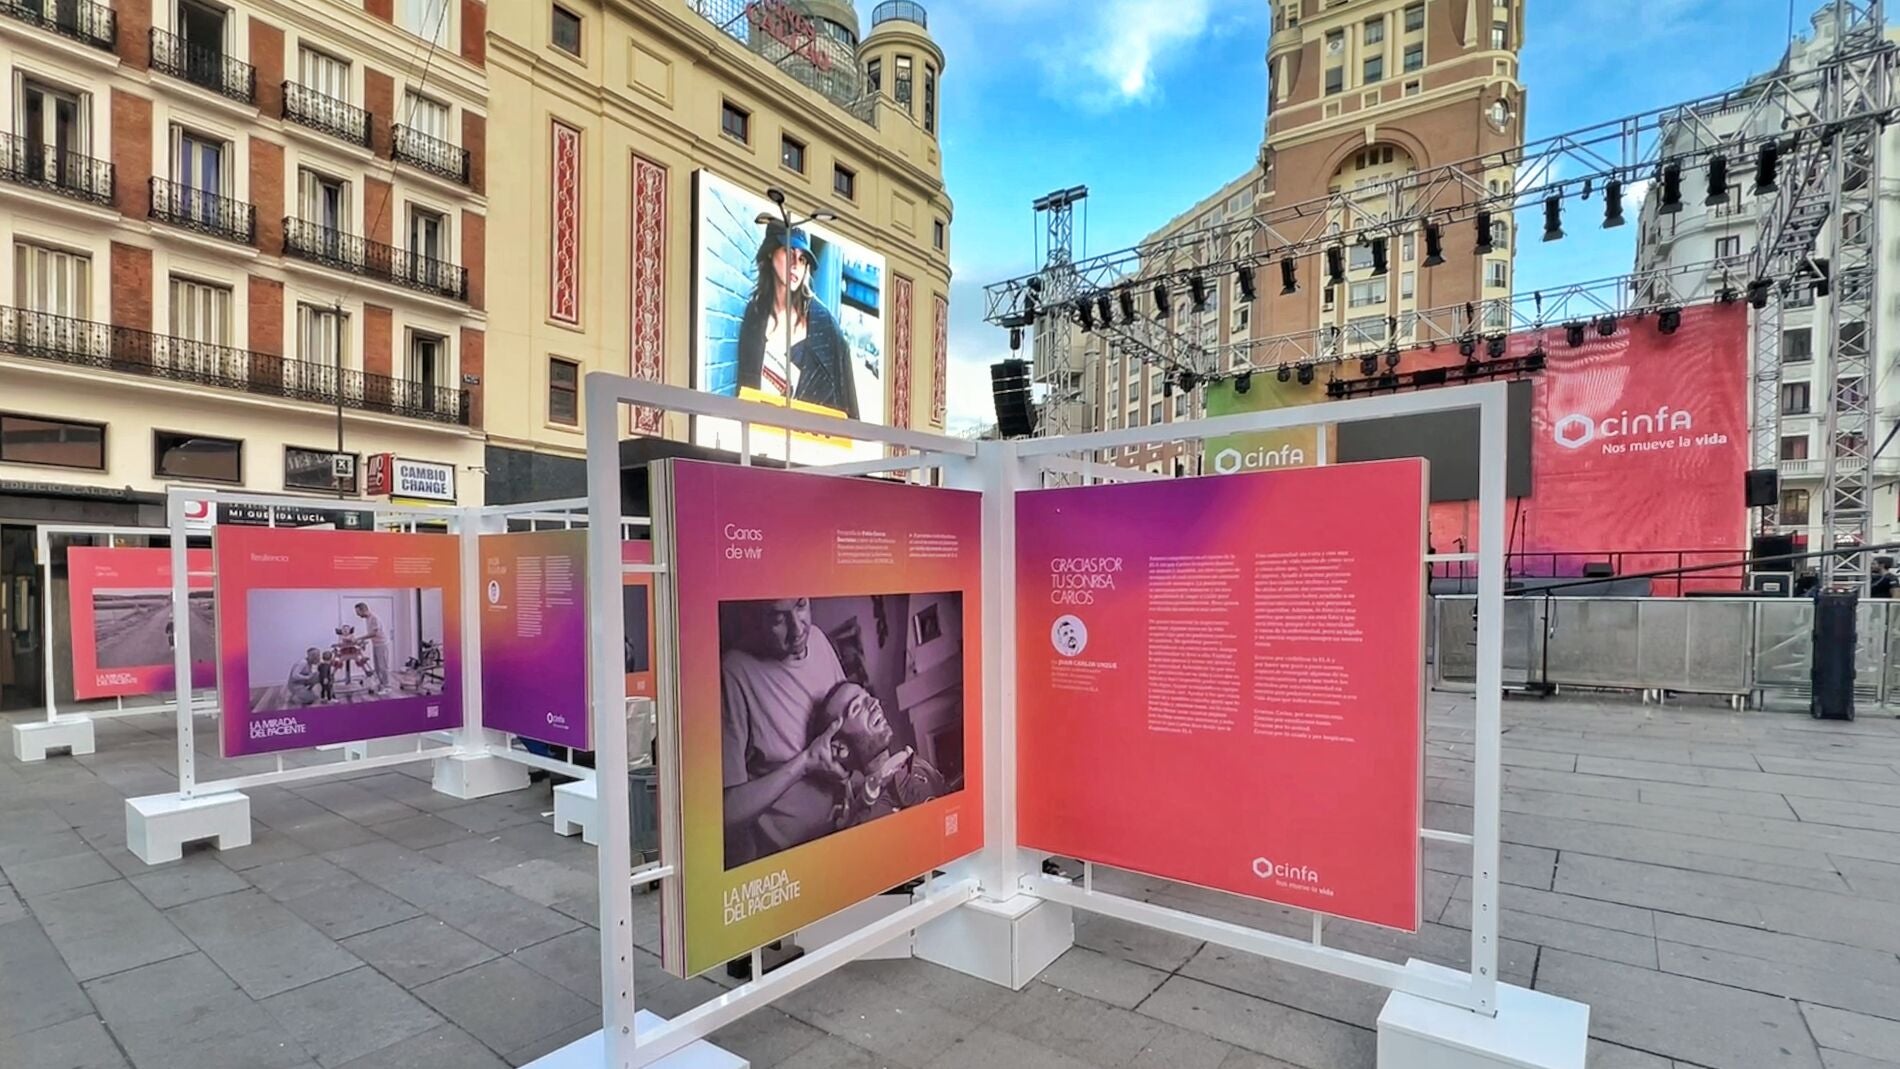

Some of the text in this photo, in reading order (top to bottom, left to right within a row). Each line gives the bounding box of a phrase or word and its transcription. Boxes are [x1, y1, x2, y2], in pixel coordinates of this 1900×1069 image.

[1602, 433, 1728, 455] Nos mueve la vida
[400, 465, 446, 482] CAMBIO
[1, 482, 125, 497] EDIFICIO CALLAO
[401, 478, 448, 494] CHANGE
[229, 505, 243, 517] MI
[247, 505, 292, 520] QUEIDA
[725, 543, 763, 559] de vivir
[1050, 556, 1123, 573] GRACIAS POR
[1050, 574, 1066, 589] TU
[1050, 589, 1094, 606] CARLOS
[250, 717, 297, 731] LA MIRADA
[250, 723, 306, 739] DEL PACIENTE
[724, 869, 789, 908] LA MIRADA
[724, 881, 800, 926] DEL PACIENTE
